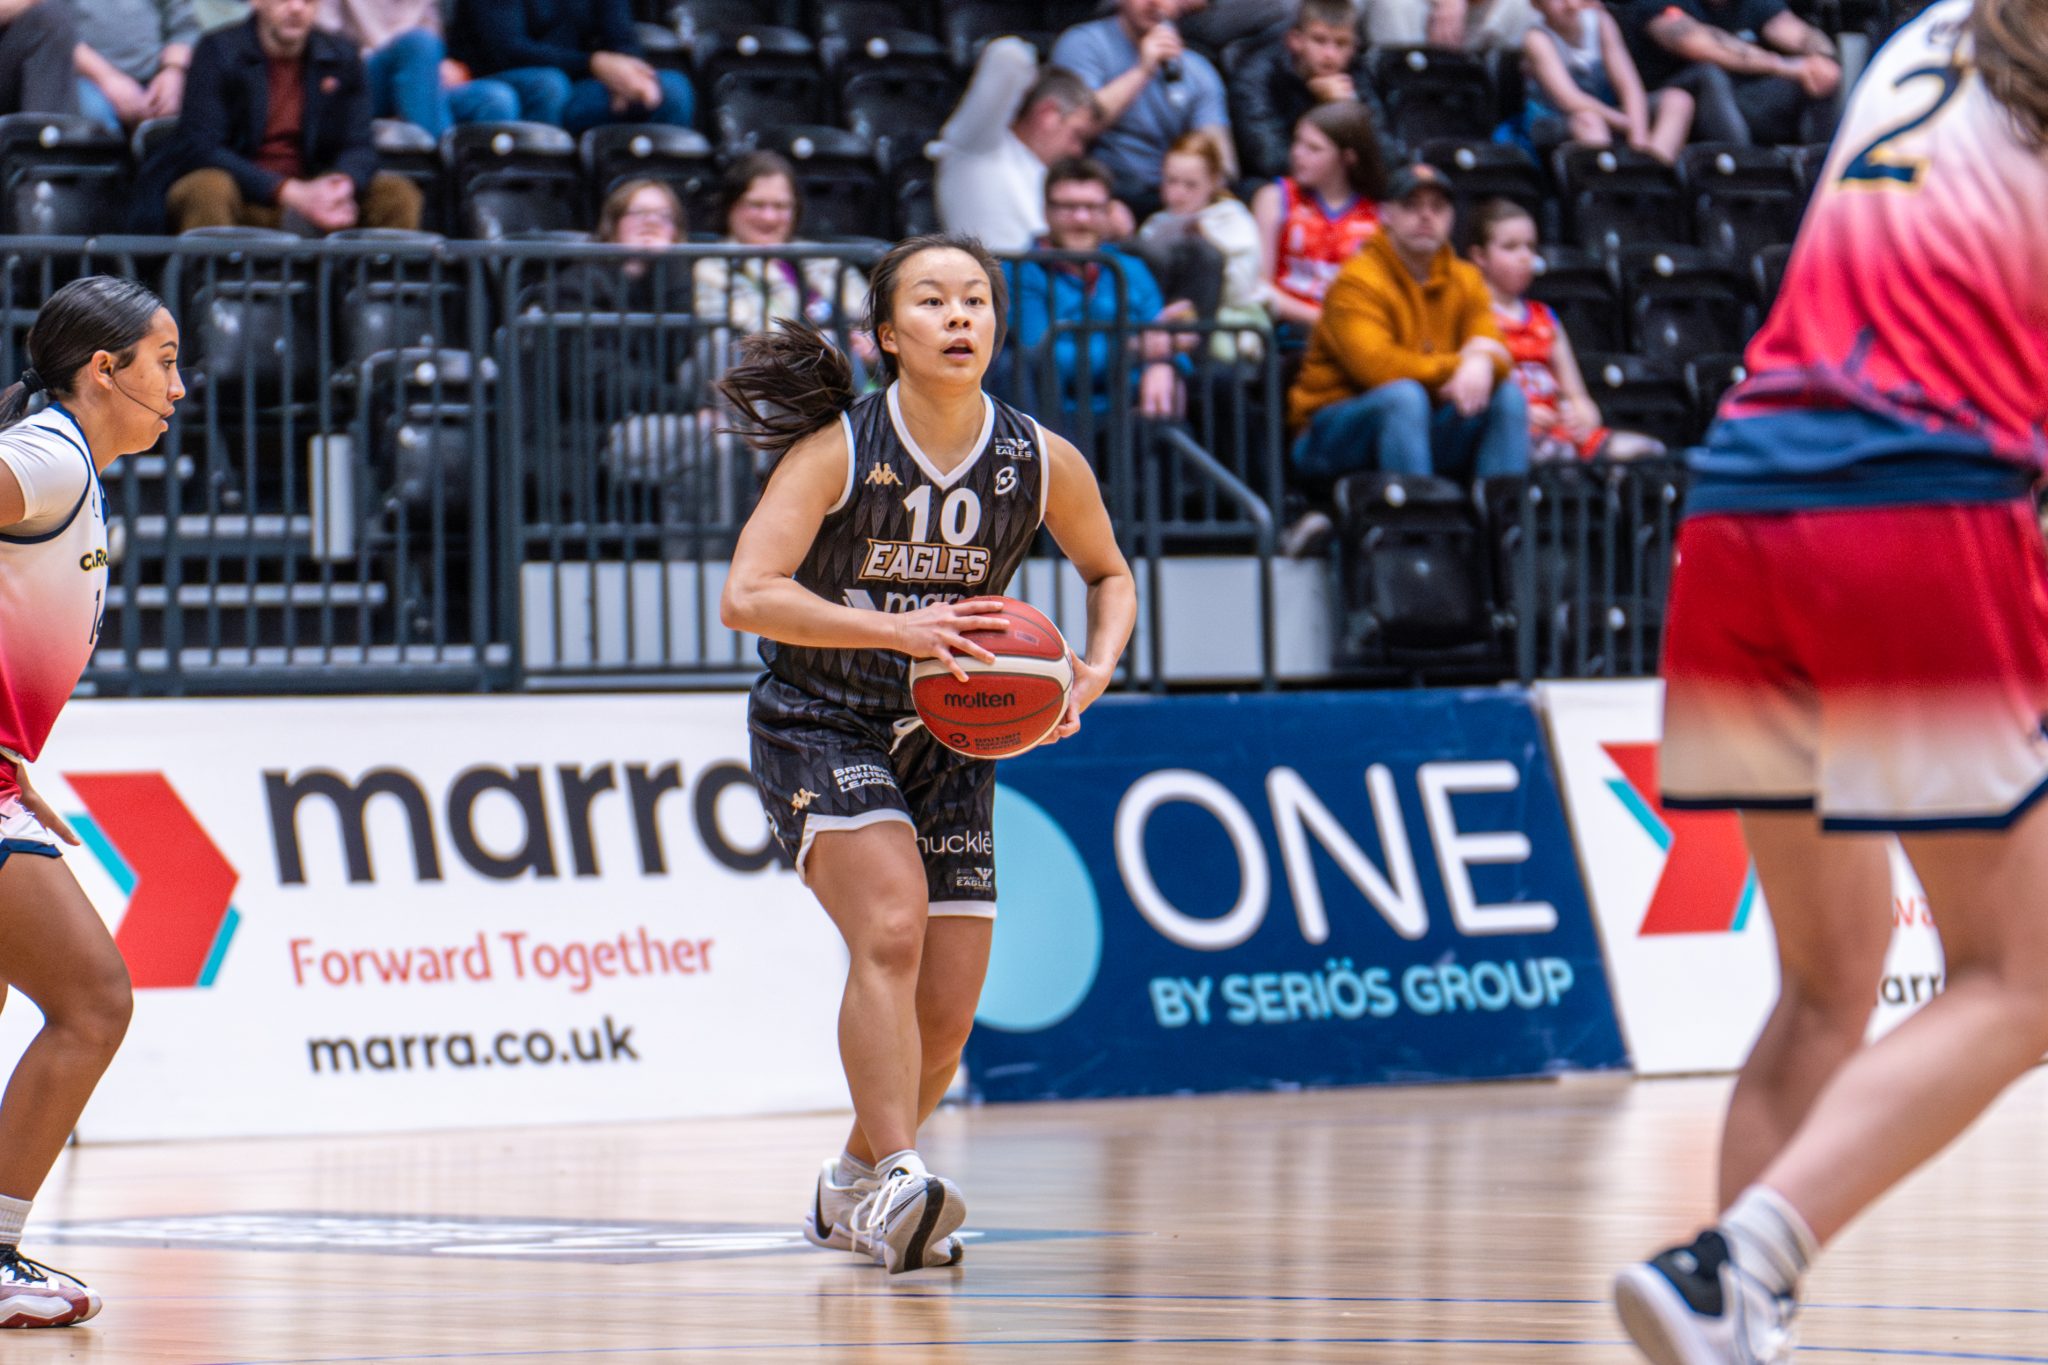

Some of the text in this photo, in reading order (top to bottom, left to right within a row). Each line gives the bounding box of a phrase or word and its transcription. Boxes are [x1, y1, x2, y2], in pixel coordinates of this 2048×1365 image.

[1839, 64, 1964, 184] 2
[903, 485, 982, 546] 10
[863, 542, 989, 584] EAGLES
[944, 692, 1017, 708] molten
[262, 759, 797, 886] marra
[1114, 761, 1559, 951] ONE
[288, 926, 715, 994] Forward Together
[1149, 957, 1575, 1028] BY SERIÖS GROUP
[307, 1015, 639, 1073] marra.co.uk
